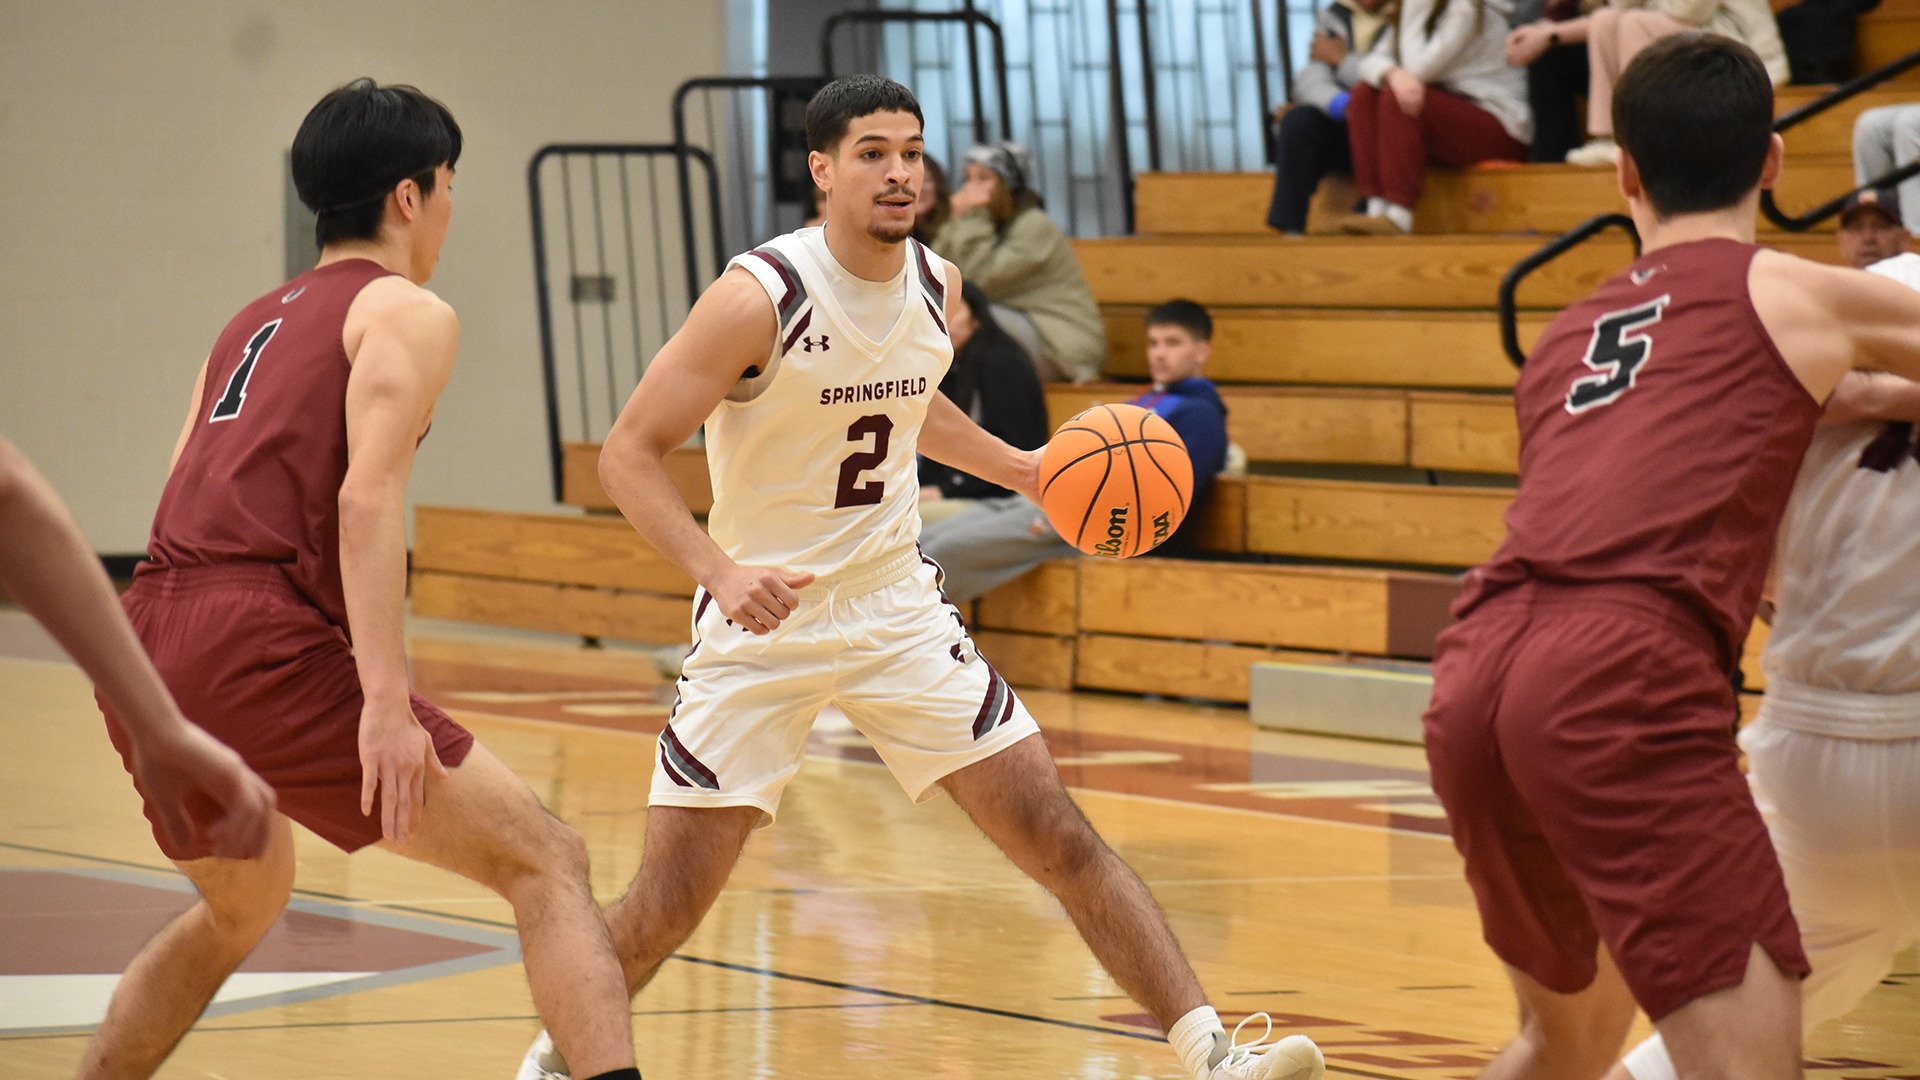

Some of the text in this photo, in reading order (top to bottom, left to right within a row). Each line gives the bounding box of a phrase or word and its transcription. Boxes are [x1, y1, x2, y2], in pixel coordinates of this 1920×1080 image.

[208, 317, 283, 424] 1
[819, 376, 927, 406] SPRINGFIELD
[1564, 293, 1671, 415] 5
[834, 413, 894, 509] 2
[1095, 507, 1128, 556] ilson
